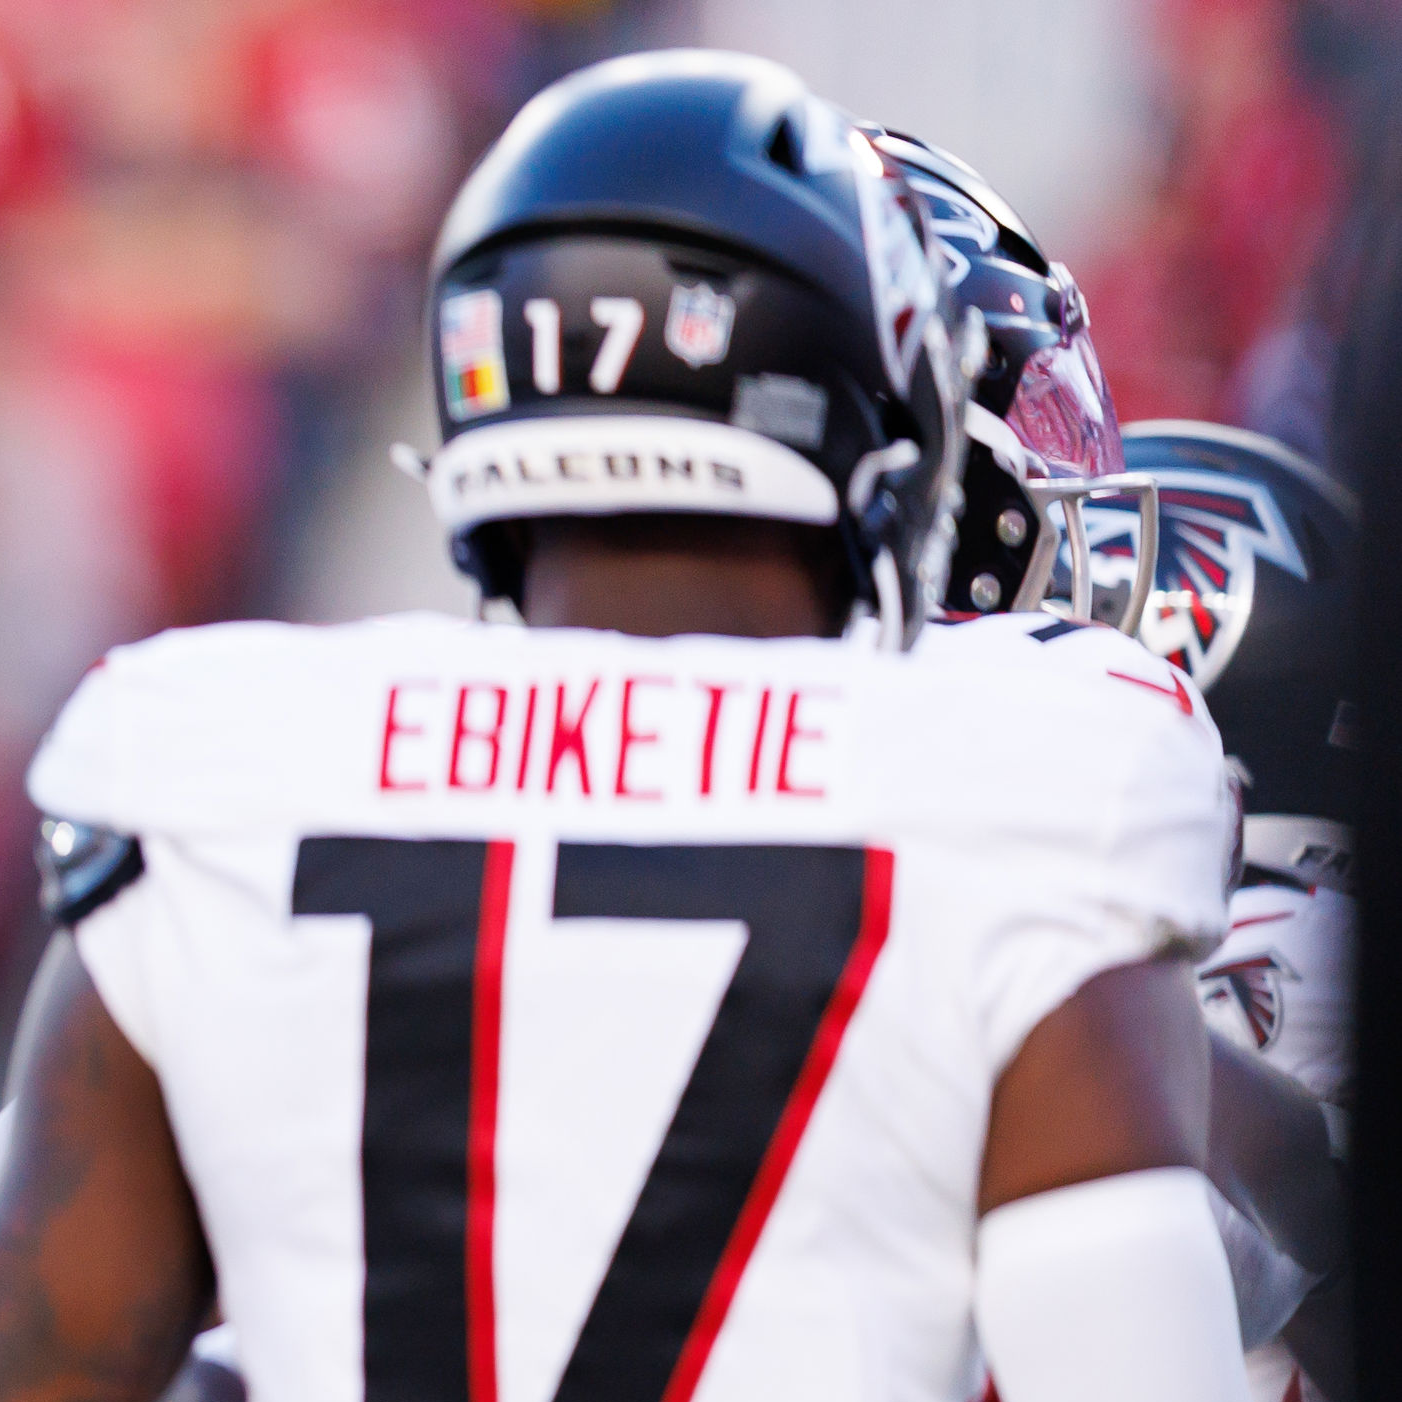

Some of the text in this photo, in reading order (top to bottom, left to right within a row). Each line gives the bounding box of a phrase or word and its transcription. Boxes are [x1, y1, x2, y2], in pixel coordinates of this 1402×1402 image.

[523, 297, 644, 395] 17
[450, 453, 745, 496] FALCONS
[379, 676, 842, 800] EBIKETIE
